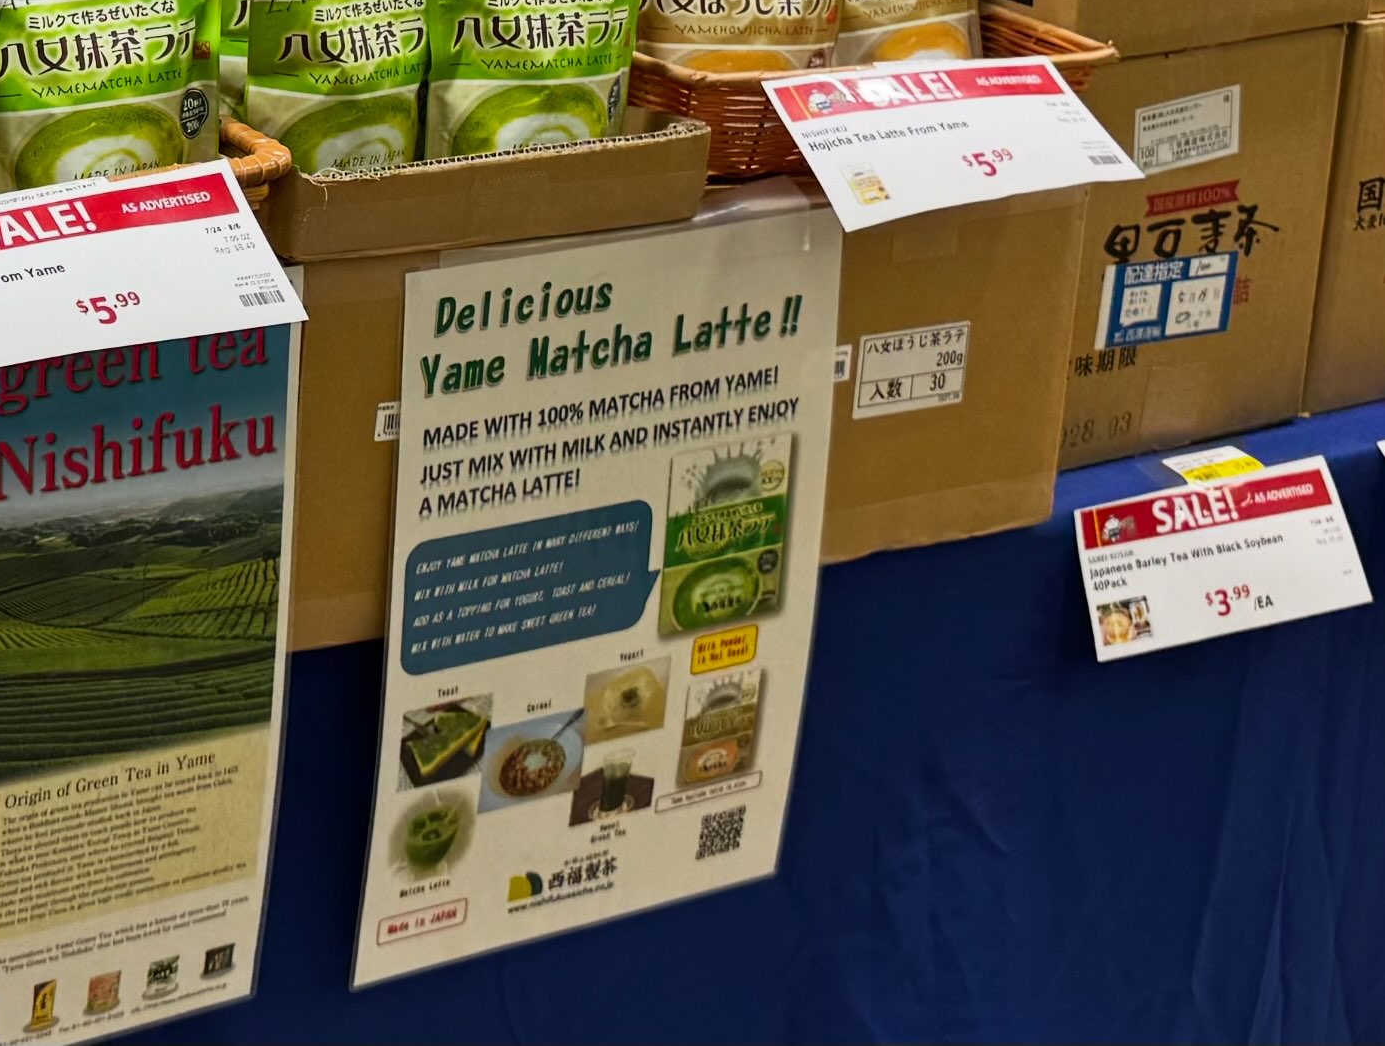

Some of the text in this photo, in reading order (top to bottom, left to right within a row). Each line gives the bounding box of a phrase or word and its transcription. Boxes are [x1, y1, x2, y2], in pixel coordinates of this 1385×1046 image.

[28, 0, 175, 29] ミルクで作るぜいたくな
[454, 10, 628, 51] 八女抹茶ラテ
[808, 119, 969, 154] Hojicha Tea Latte From Yame
[122, 202, 138, 214] AS
[139, 190, 211, 211] ADVERTISED
[27, 262, 65, 281] Yame
[1124, 260, 1183, 285] 配達指定
[434, 281, 614, 337] Delicious
[186, 325, 269, 377] tea
[867, 329, 965, 354] 八女ほうじ茶ラテ
[937, 351, 963, 366] 200g
[420, 353, 506, 398] Yame
[527, 324, 653, 380] Matcha
[870, 372, 945, 401] 入数 30
[422, 365, 779, 448] MADE WITH 100% MATCHA FROM YAME!
[420, 398, 799, 485] JUST MIX WITH MILK AND INSTANTLY ENJOY
[419, 469, 581, 516] A MATCHA LATTE!
[1152, 483, 1314, 534] SALE! AS ADVERTISED
[1089, 561, 1133, 580] Japanese
[1136, 555, 1167, 570] Barley
[1170, 552, 1189, 563] Tea
[1191, 546, 1214, 559] With
[1217, 541, 1242, 555] Black
[1245, 533, 1284, 550] Soybean
[1093, 577, 1128, 592] 40Pack
[1253, 597, 1273, 611] /EA
[5, 752, 216, 809] Origin of Green Tea in Yame
[548, 856, 617, 890] 西福製茶
